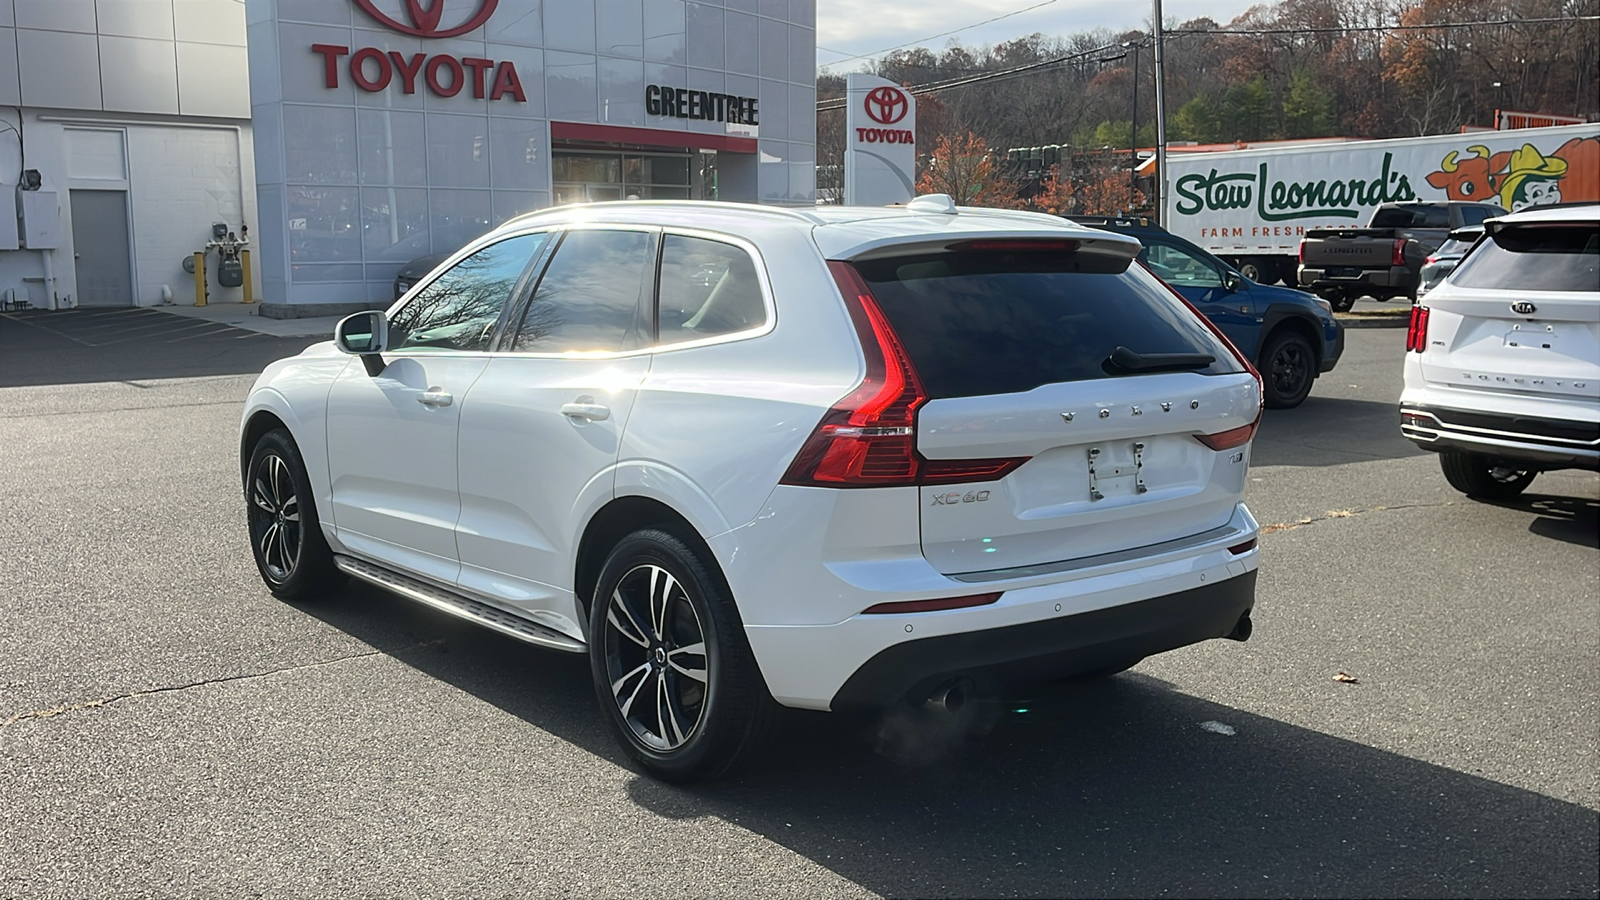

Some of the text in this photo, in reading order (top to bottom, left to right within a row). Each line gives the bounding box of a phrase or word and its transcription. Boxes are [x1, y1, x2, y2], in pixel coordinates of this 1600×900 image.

[312, 43, 527, 102] TOYOTA
[645, 84, 759, 126] GREENTREE
[856, 127, 915, 145] TOYOTA
[1175, 151, 1416, 222] Stew Leonard's
[1201, 227, 1243, 238] FARM
[1252, 226, 1304, 237] FRESH
[1514, 302, 1533, 313] KIA
[1060, 399, 1200, 423] VOLVO
